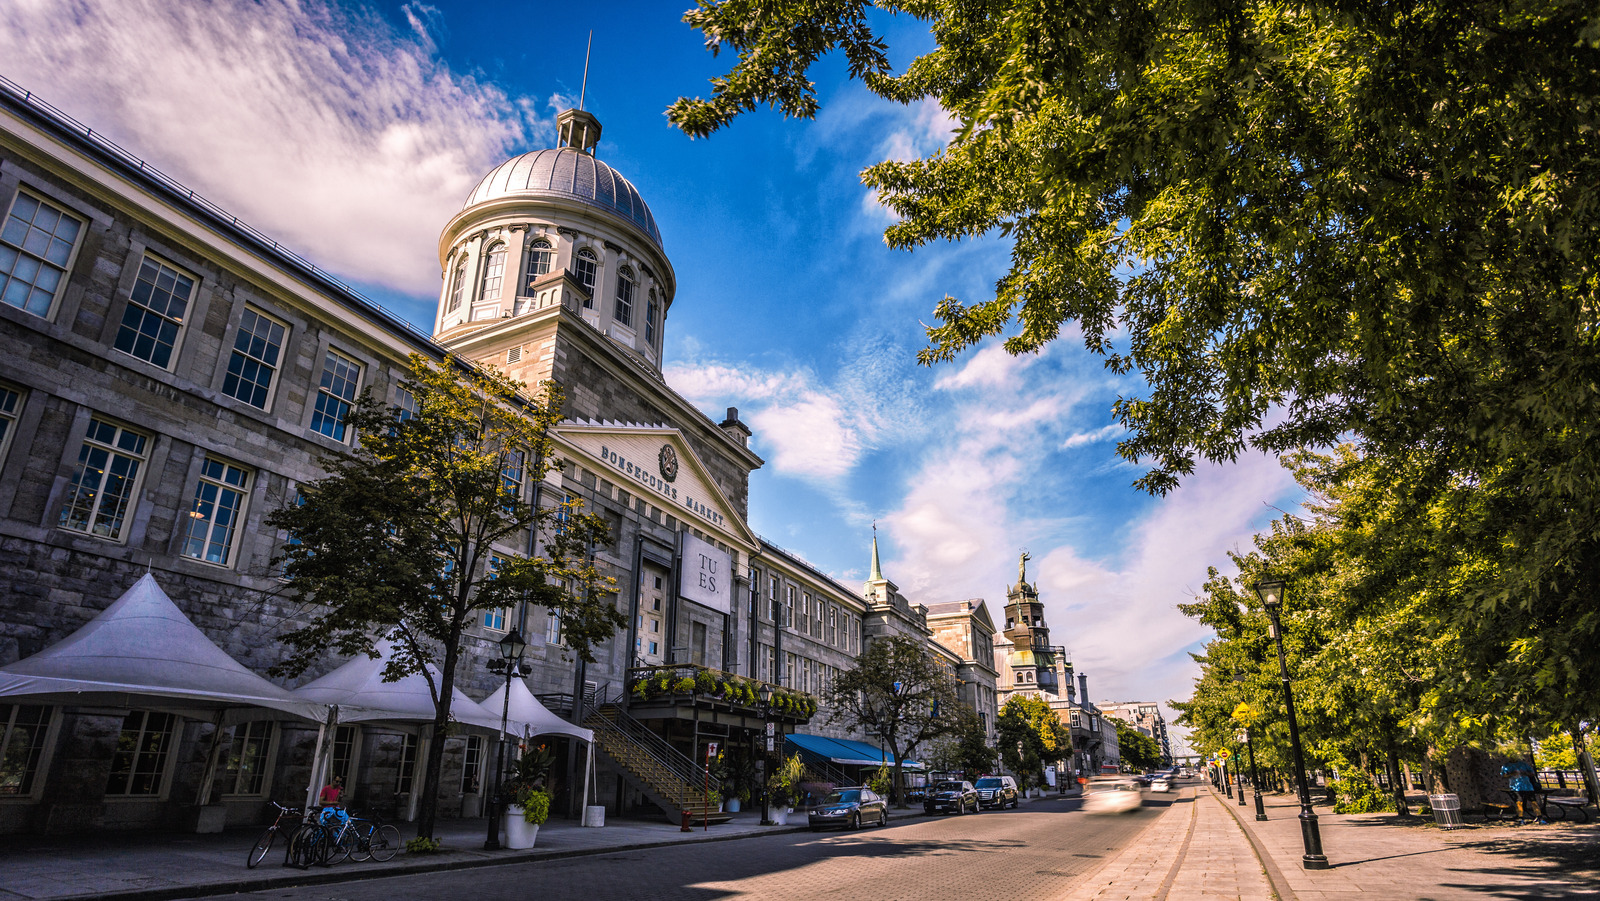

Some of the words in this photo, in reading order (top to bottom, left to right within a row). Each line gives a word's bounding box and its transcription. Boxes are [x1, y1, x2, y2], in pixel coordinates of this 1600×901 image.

[601, 446, 678, 500] BONSECOURS
[698, 553, 717, 574] TU
[698, 572, 719, 594] ES.
